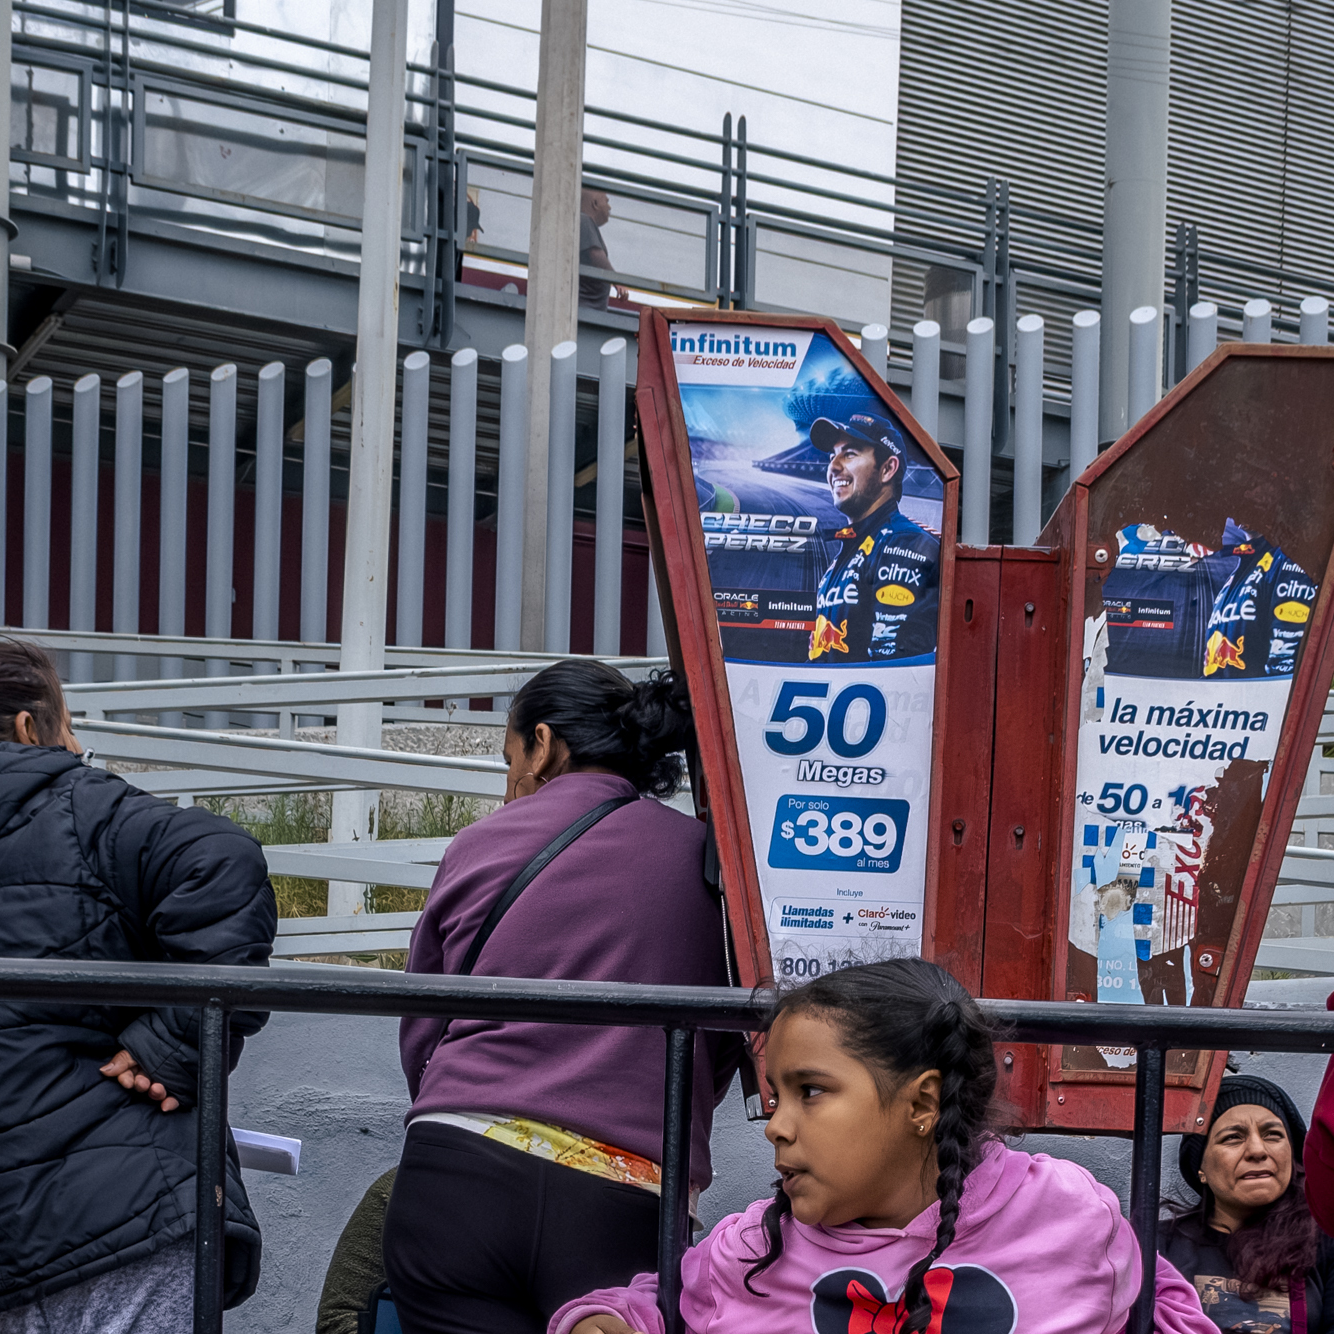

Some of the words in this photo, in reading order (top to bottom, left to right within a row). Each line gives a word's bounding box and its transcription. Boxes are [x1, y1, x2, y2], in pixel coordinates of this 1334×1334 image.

[671, 332, 797, 357] infinitum
[693, 355, 730, 367] Exceso
[732, 356, 744, 367] de
[747, 357, 796, 370] Velocidad
[700, 512, 817, 534] CHECO
[883, 545, 926, 562] infinitum
[878, 563, 921, 586] citrix
[714, 592, 759, 601] ORACLE
[768, 601, 812, 611] infinitum
[1138, 607, 1171, 615] infinitum
[763, 680, 888, 759] 50
[1110, 698, 1137, 724] la
[1145, 701, 1269, 732] máxima
[1099, 731, 1250, 761] velocidad
[797, 759, 886, 787] Megas
[788, 799, 805, 809] Por
[808, 800, 829, 810] solo
[1077, 791, 1094, 805] de
[1097, 782, 1148, 815] 50
[1152, 798, 1163, 809] a
[780, 810, 897, 858] $389
[857, 858, 866, 867] al
[868, 860, 889, 868] mes
[836, 888, 863, 898] Incluye
[782, 905, 834, 918] Llamadas
[890, 909, 916, 920] video
[780, 917, 834, 929] ilimitadas
[782, 957, 820, 976] 800
